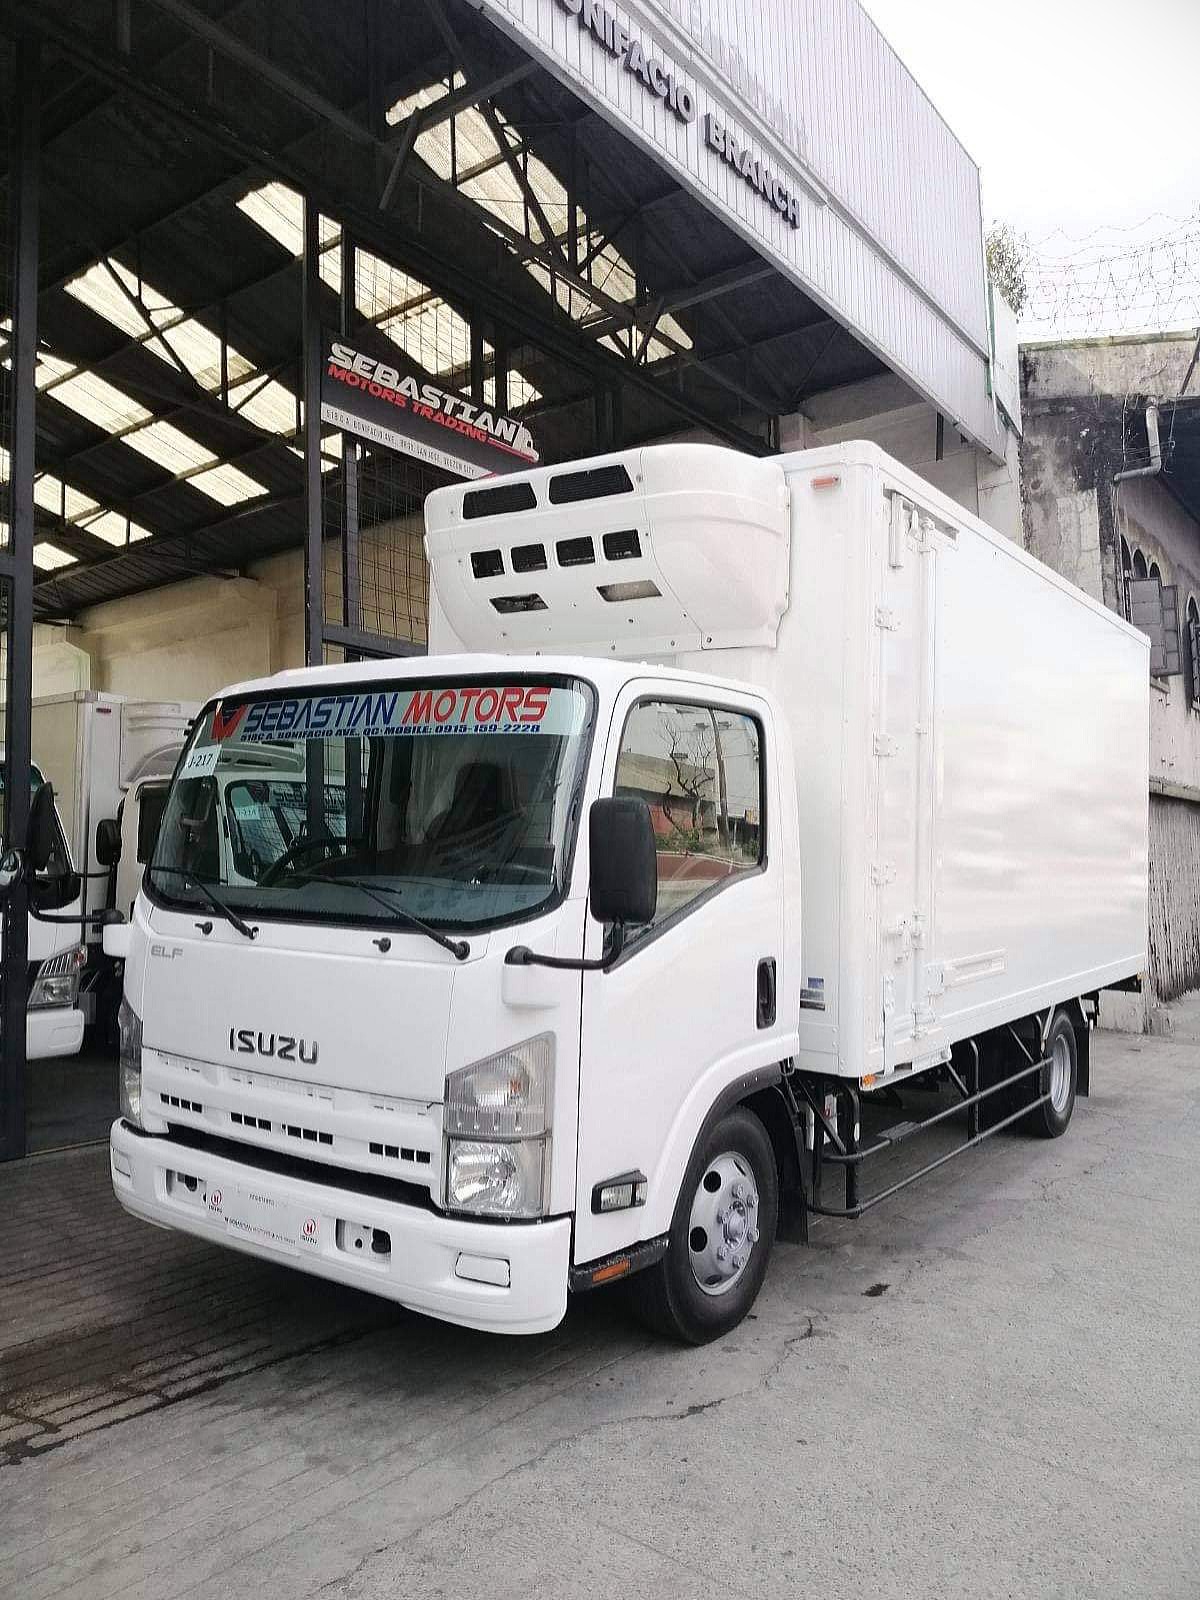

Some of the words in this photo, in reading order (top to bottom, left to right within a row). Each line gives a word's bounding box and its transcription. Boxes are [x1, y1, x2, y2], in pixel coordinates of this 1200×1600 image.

[704, 112, 800, 230] BRANCH
[328, 342, 521, 444] SEBASTIAN
[328, 363, 408, 409] MOTORS
[412, 400, 488, 442] TRADING
[244, 692, 399, 733] SEBASTIAN
[402, 687, 552, 725] MOTORS
[278, 729, 333, 739] BONIFACIO
[435, 723, 541, 733] 0915-159-2228
[188, 753, 213, 768] J-217
[151, 944, 184, 960] ELF
[229, 1027, 318, 1065] ISUZU
